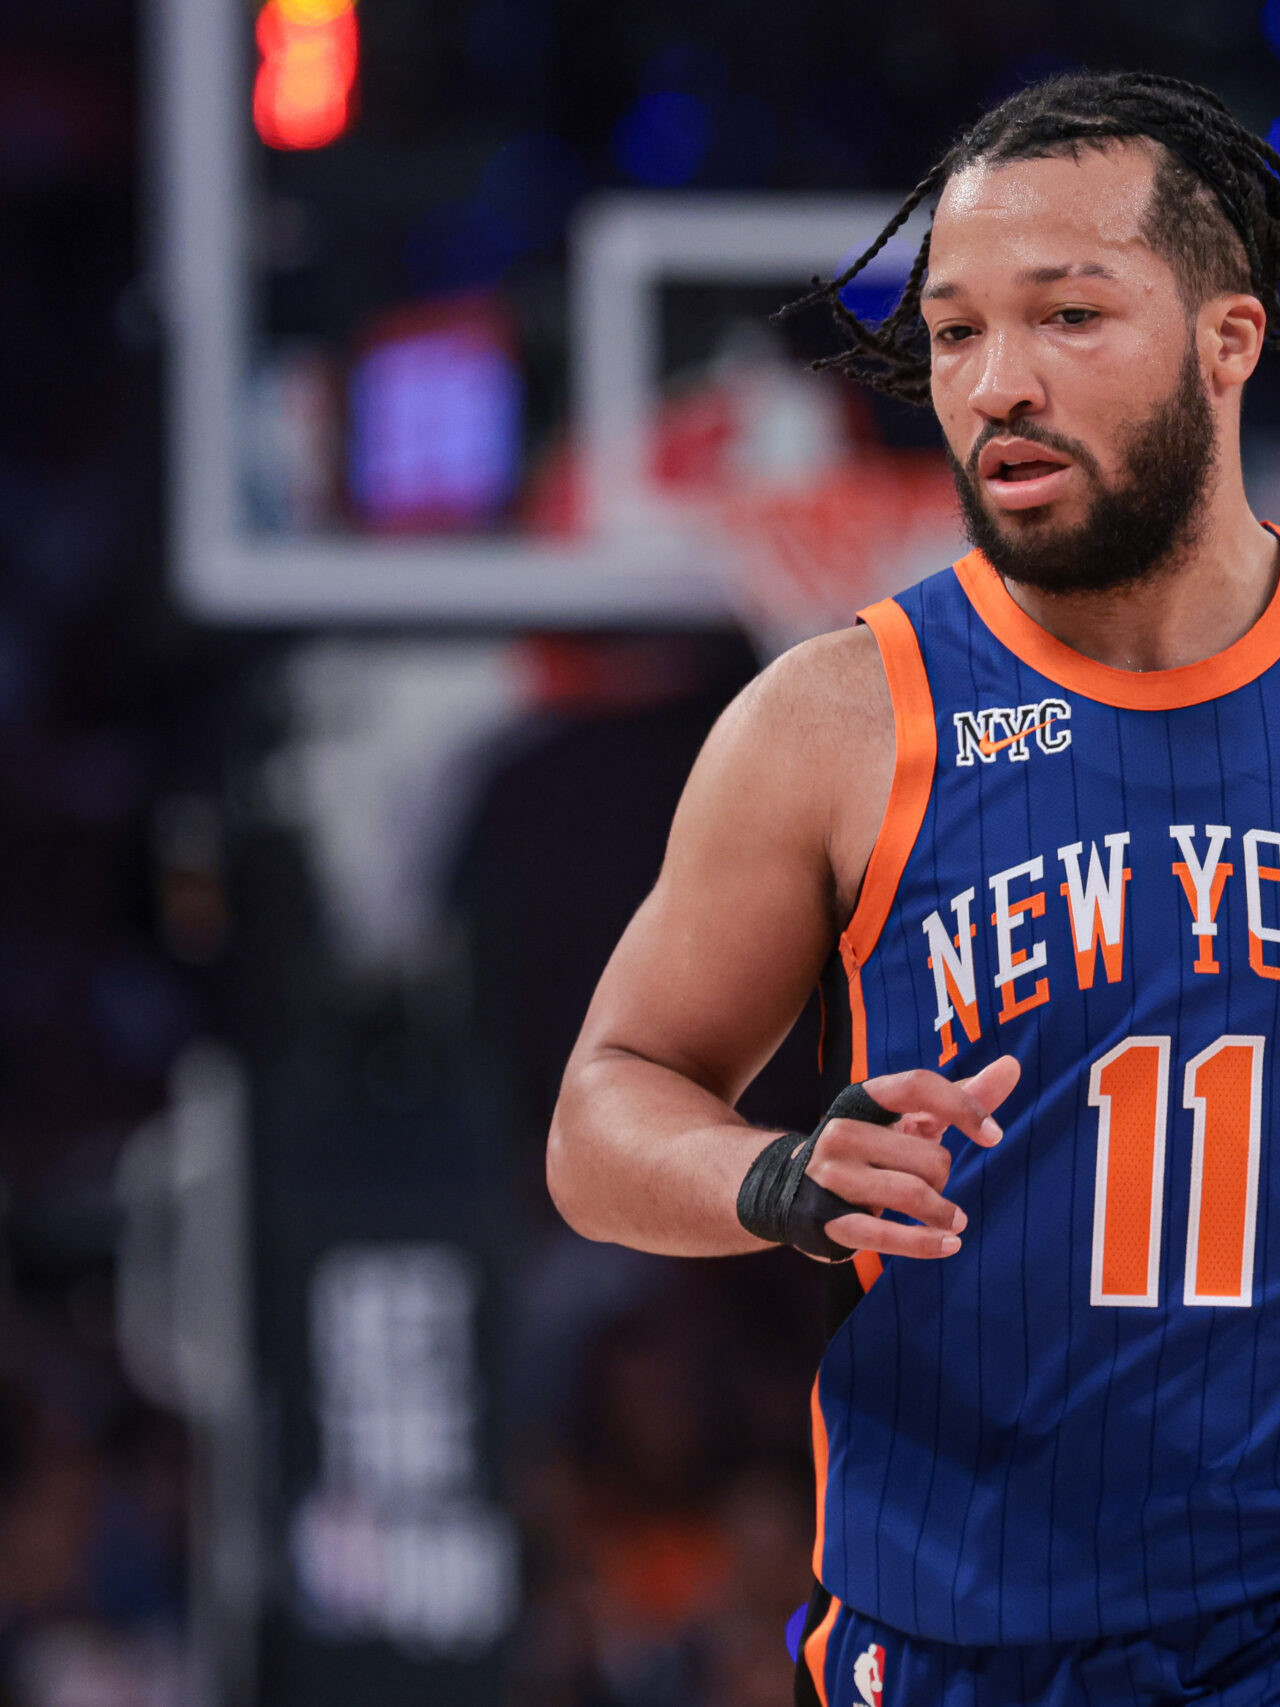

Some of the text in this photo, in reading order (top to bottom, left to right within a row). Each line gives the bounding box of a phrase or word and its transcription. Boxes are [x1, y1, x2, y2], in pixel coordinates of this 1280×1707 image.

[953, 698, 1072, 767] NYC
[922, 832, 1133, 1068] NEW
[1088, 1035, 1266, 1308] 11
